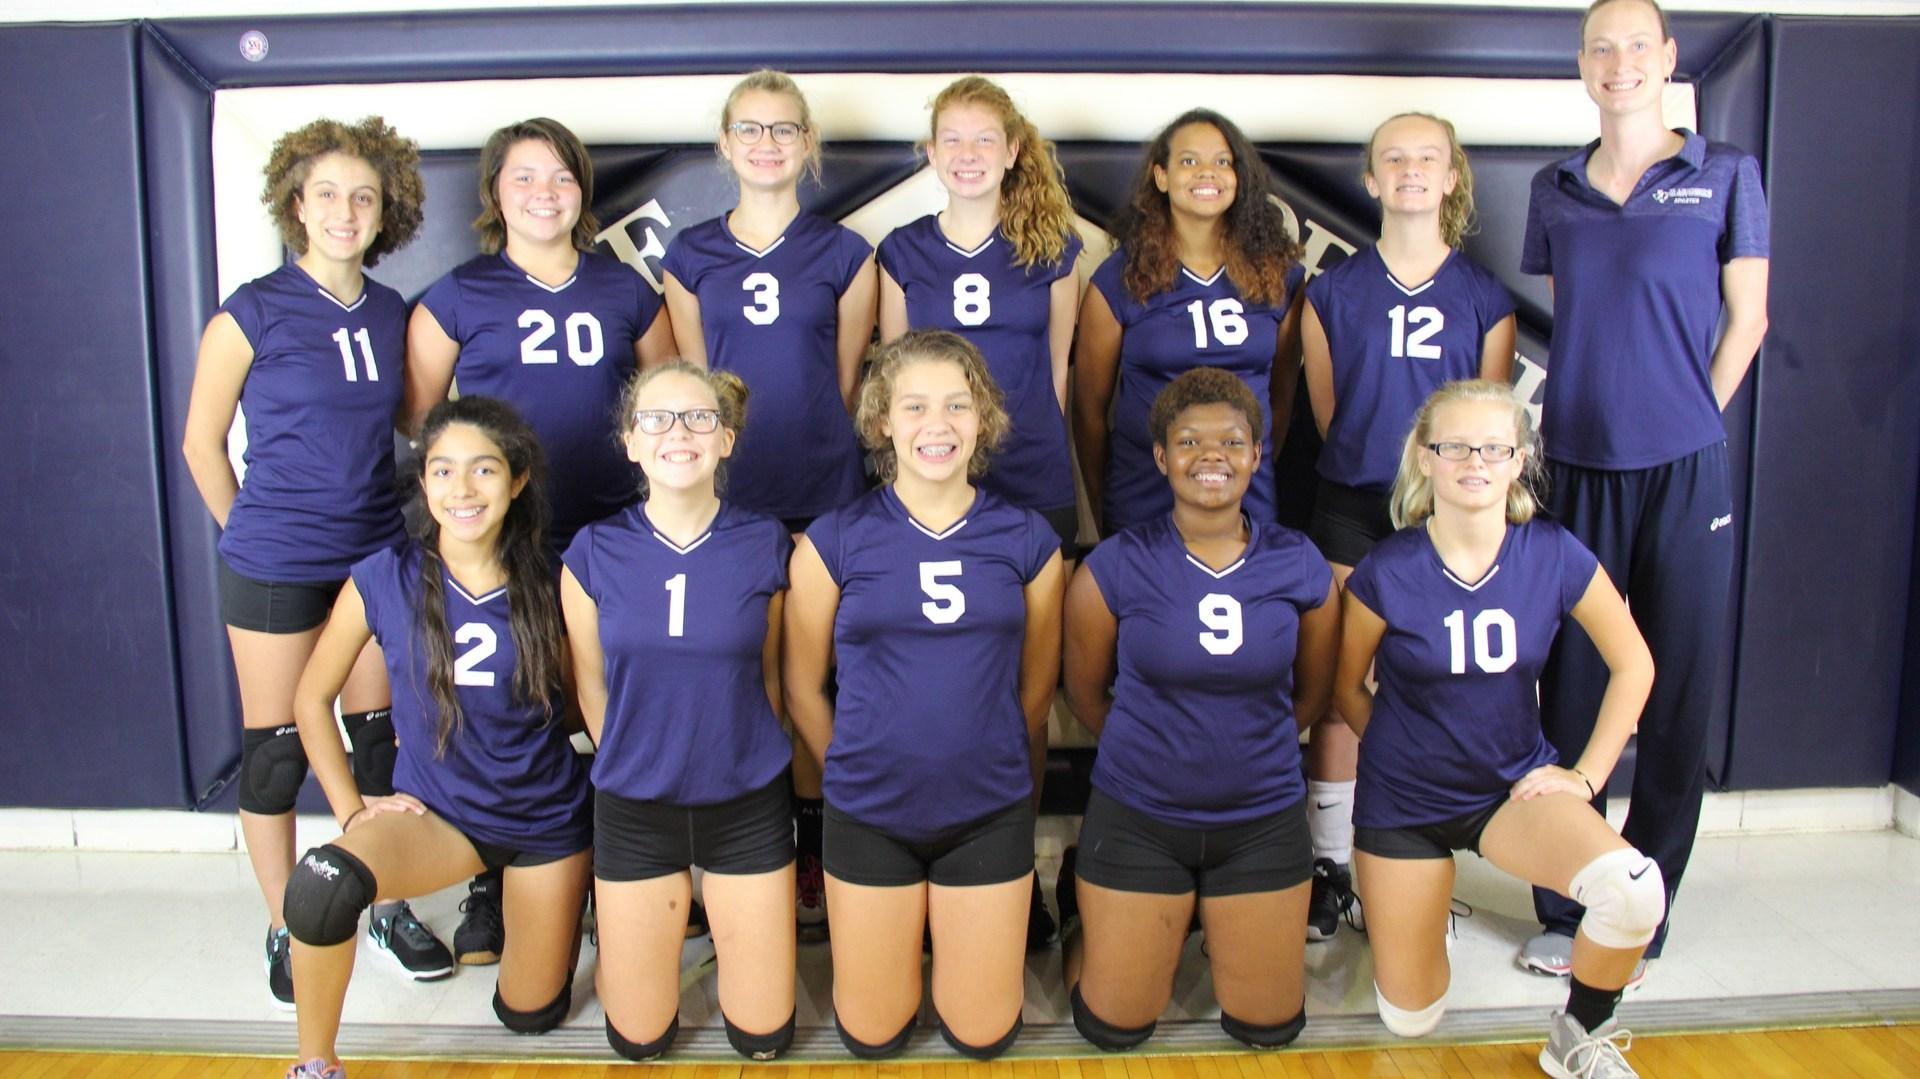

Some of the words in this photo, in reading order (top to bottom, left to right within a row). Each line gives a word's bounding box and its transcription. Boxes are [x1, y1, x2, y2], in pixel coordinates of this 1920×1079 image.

[743, 272, 780, 325] 3
[953, 273, 990, 326] 8
[1187, 297, 1249, 348] 16
[332, 327, 379, 382] 11
[517, 309, 604, 367] 20
[1388, 304, 1445, 360] 12
[664, 573, 687, 637] 1
[919, 560, 966, 625] 5
[1198, 592, 1244, 656] 9
[1443, 608, 1517, 674] 10
[453, 622, 498, 687] 2
